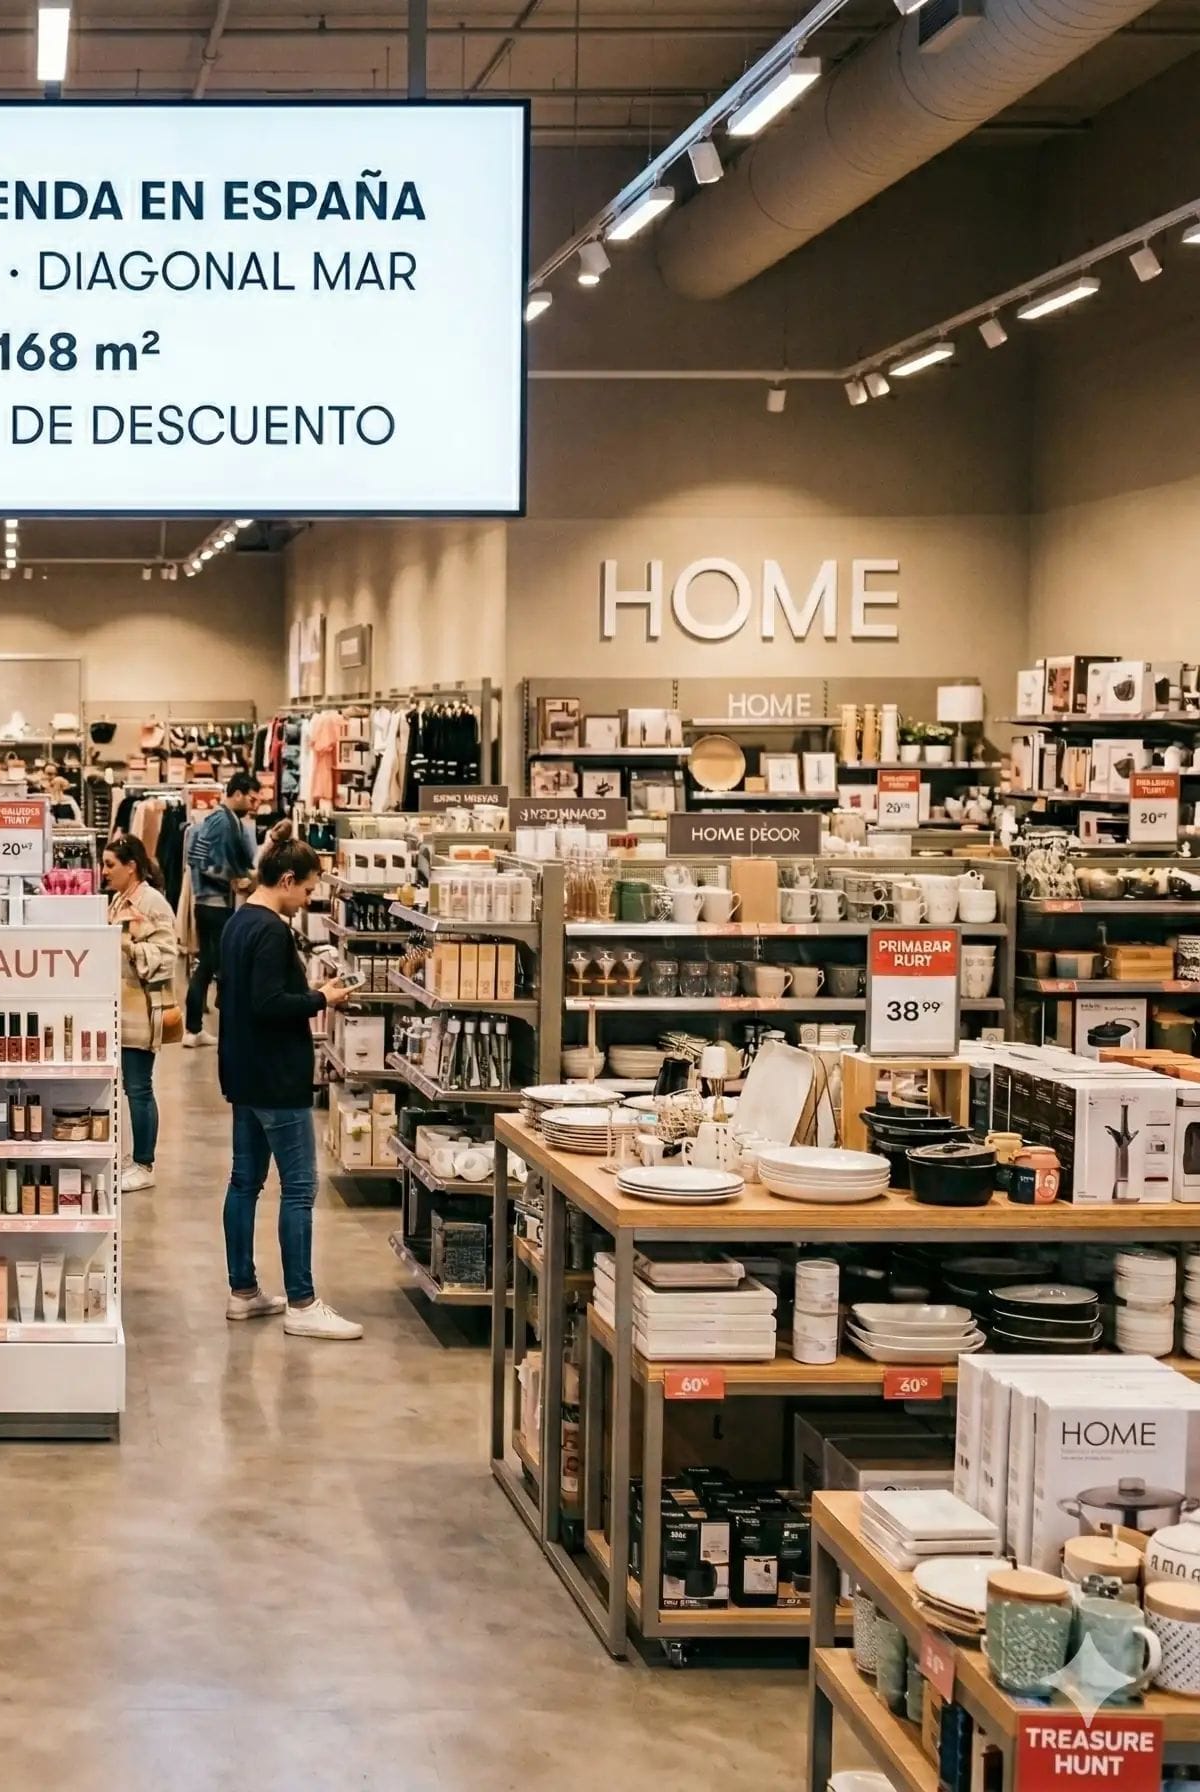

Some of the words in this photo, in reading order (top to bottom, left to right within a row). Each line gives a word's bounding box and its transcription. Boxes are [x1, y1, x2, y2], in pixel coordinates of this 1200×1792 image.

[142, 180, 203, 220] EN
[225, 169, 425, 220] ESPAÑA
[39, 250, 295, 291] DIAGONAL
[314, 251, 417, 291] MAR
[95, 331, 161, 371] m²
[13, 405, 72, 445] DE
[92, 404, 395, 446] DESCUENTO
[601, 557, 899, 640] HOME
[727, 692, 812, 718] HOME
[691, 827, 745, 842] HOME
[1062, 1421, 1156, 1446] HOME
[1025, 1728, 1155, 1752] TREASURE
[1054, 1754, 1125, 1777] HUNT
